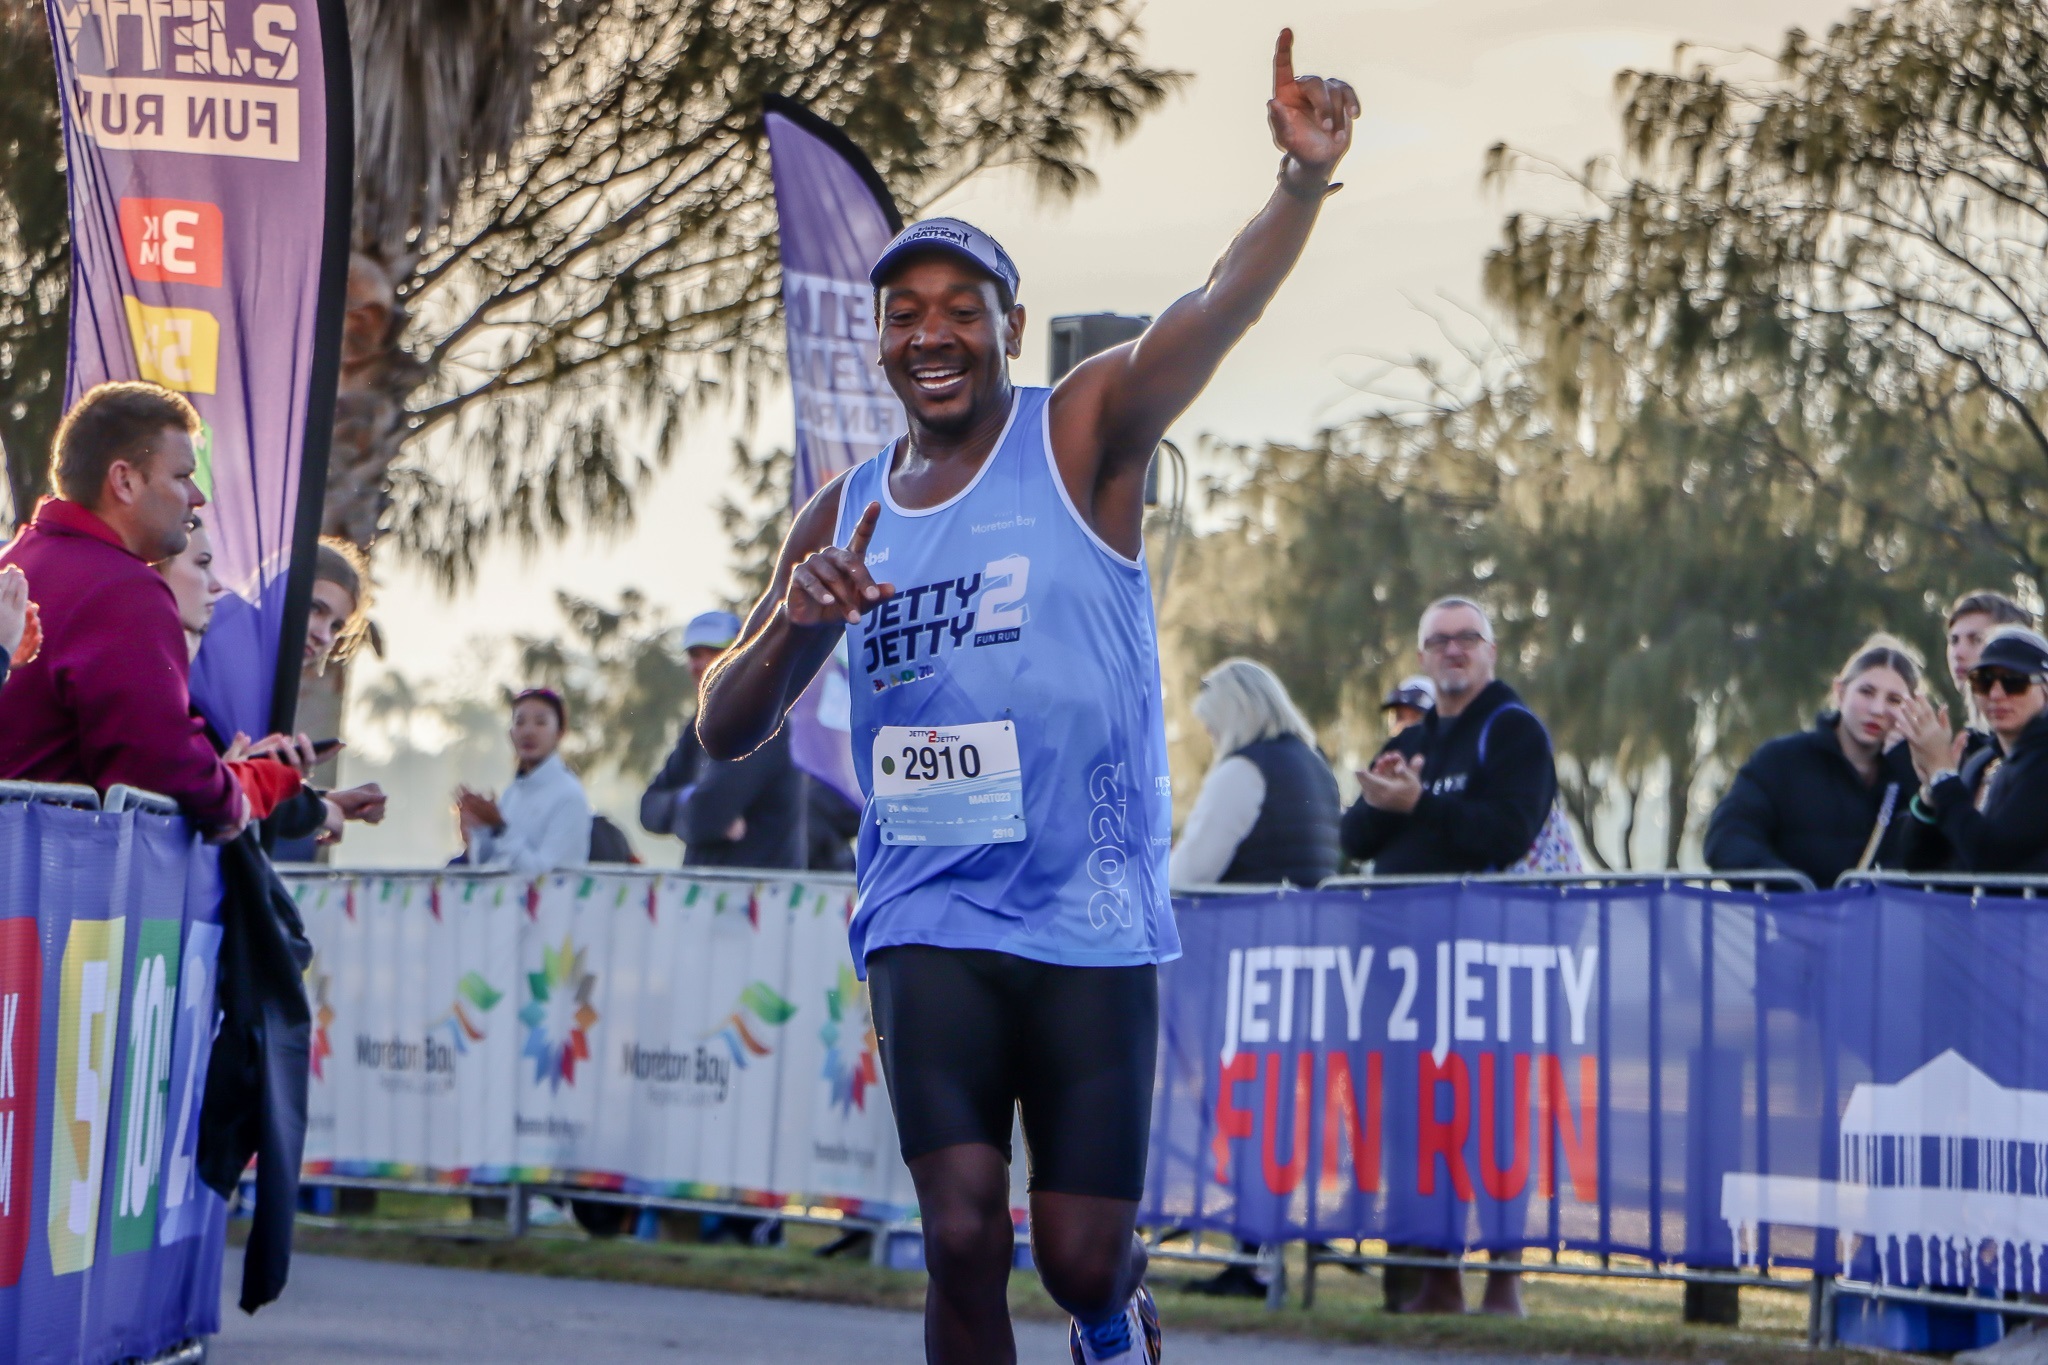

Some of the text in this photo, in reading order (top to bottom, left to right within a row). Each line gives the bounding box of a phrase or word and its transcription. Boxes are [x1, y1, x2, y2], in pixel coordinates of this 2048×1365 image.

[971, 515, 1037, 535] Moreton Bay
[864, 556, 1031, 636] JETTY 2
[864, 611, 976, 675] JETTY
[976, 631, 1018, 645] FUN RUN
[902, 744, 981, 781] 2910
[909, 730, 937, 743] JETTY 2
[936, 735, 960, 743] JETTY
[992, 827, 1015, 839] 2910
[1086, 761, 1132, 931] 2022
[1220, 938, 1599, 1069] JETTY 2 JETTY
[67, 960, 108, 1235] 5
[119, 953, 166, 1218] 10
[694, 1044, 731, 1103] Bay
[1211, 1051, 1599, 1204] FUN RUN
